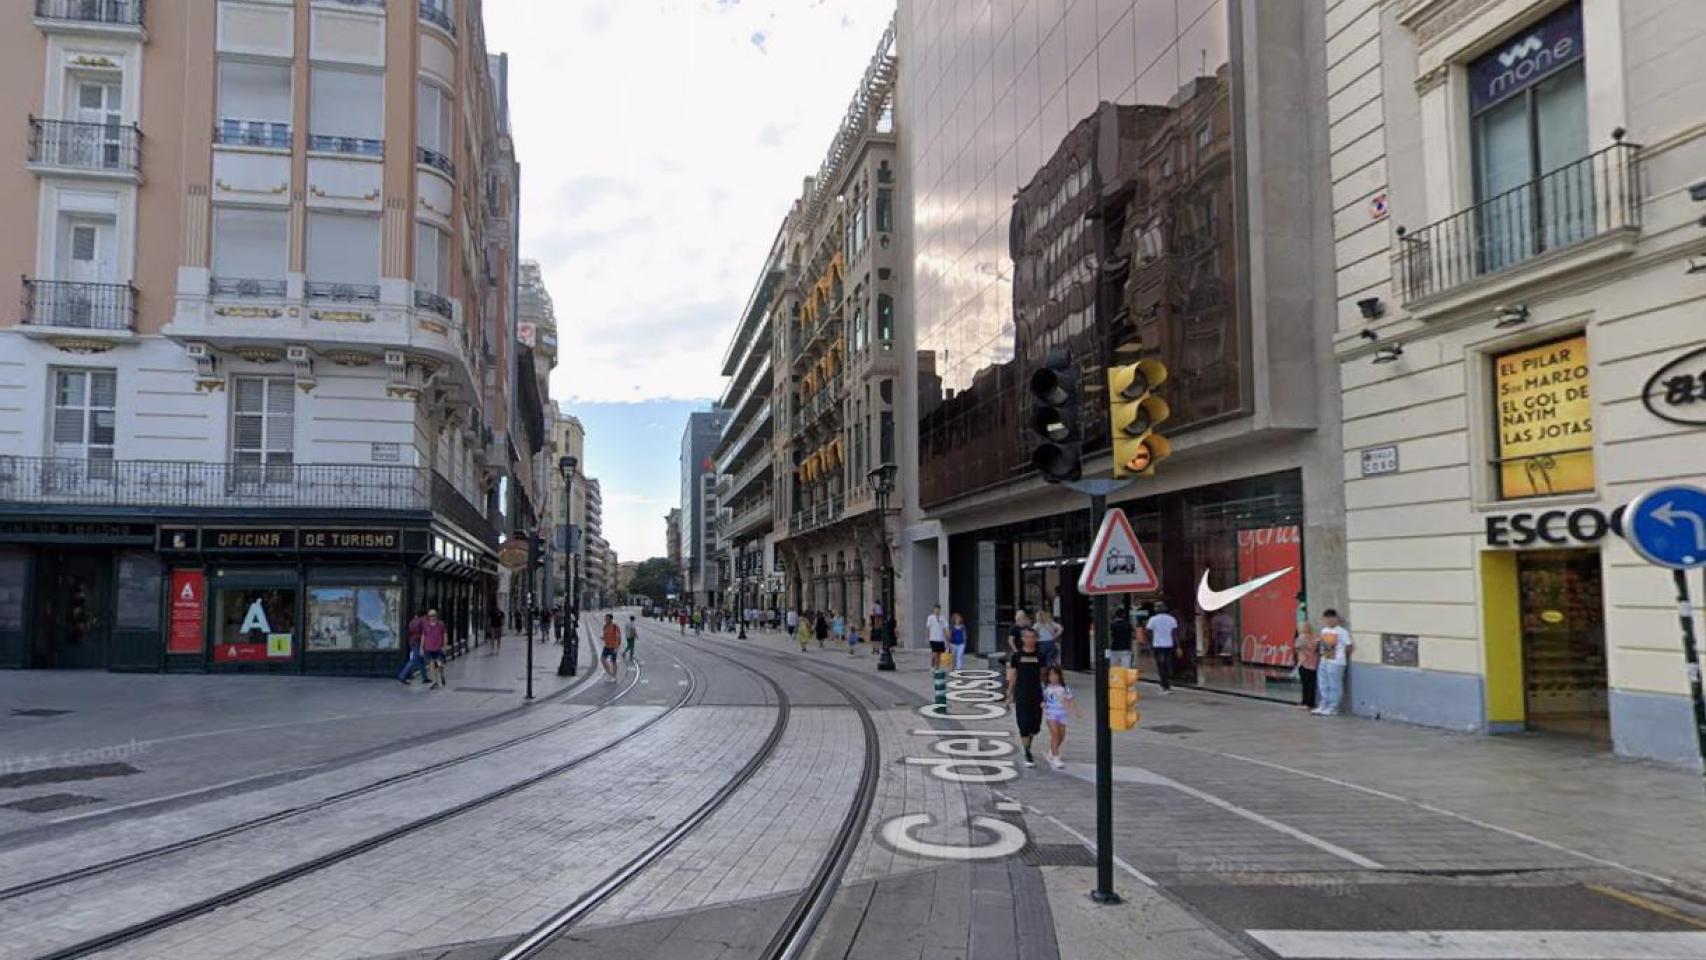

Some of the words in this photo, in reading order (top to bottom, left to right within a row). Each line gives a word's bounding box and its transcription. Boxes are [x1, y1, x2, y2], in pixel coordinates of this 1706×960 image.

[1489, 37, 1573, 97] mone
[1501, 364, 1516, 376] EL
[1522, 349, 1570, 371] PILAR
[1525, 366, 1588, 390] MARZO
[1502, 401, 1518, 413] EL
[1524, 392, 1560, 409] GOL
[1566, 385, 1589, 401] DE
[1503, 407, 1556, 427] NAYIM
[1504, 429, 1533, 445] LAS
[1538, 419, 1592, 440] JOTAS
[218, 533, 280, 547] OFICINA
[305, 534, 325, 547] DE
[333, 534, 394, 548] TURISMO
